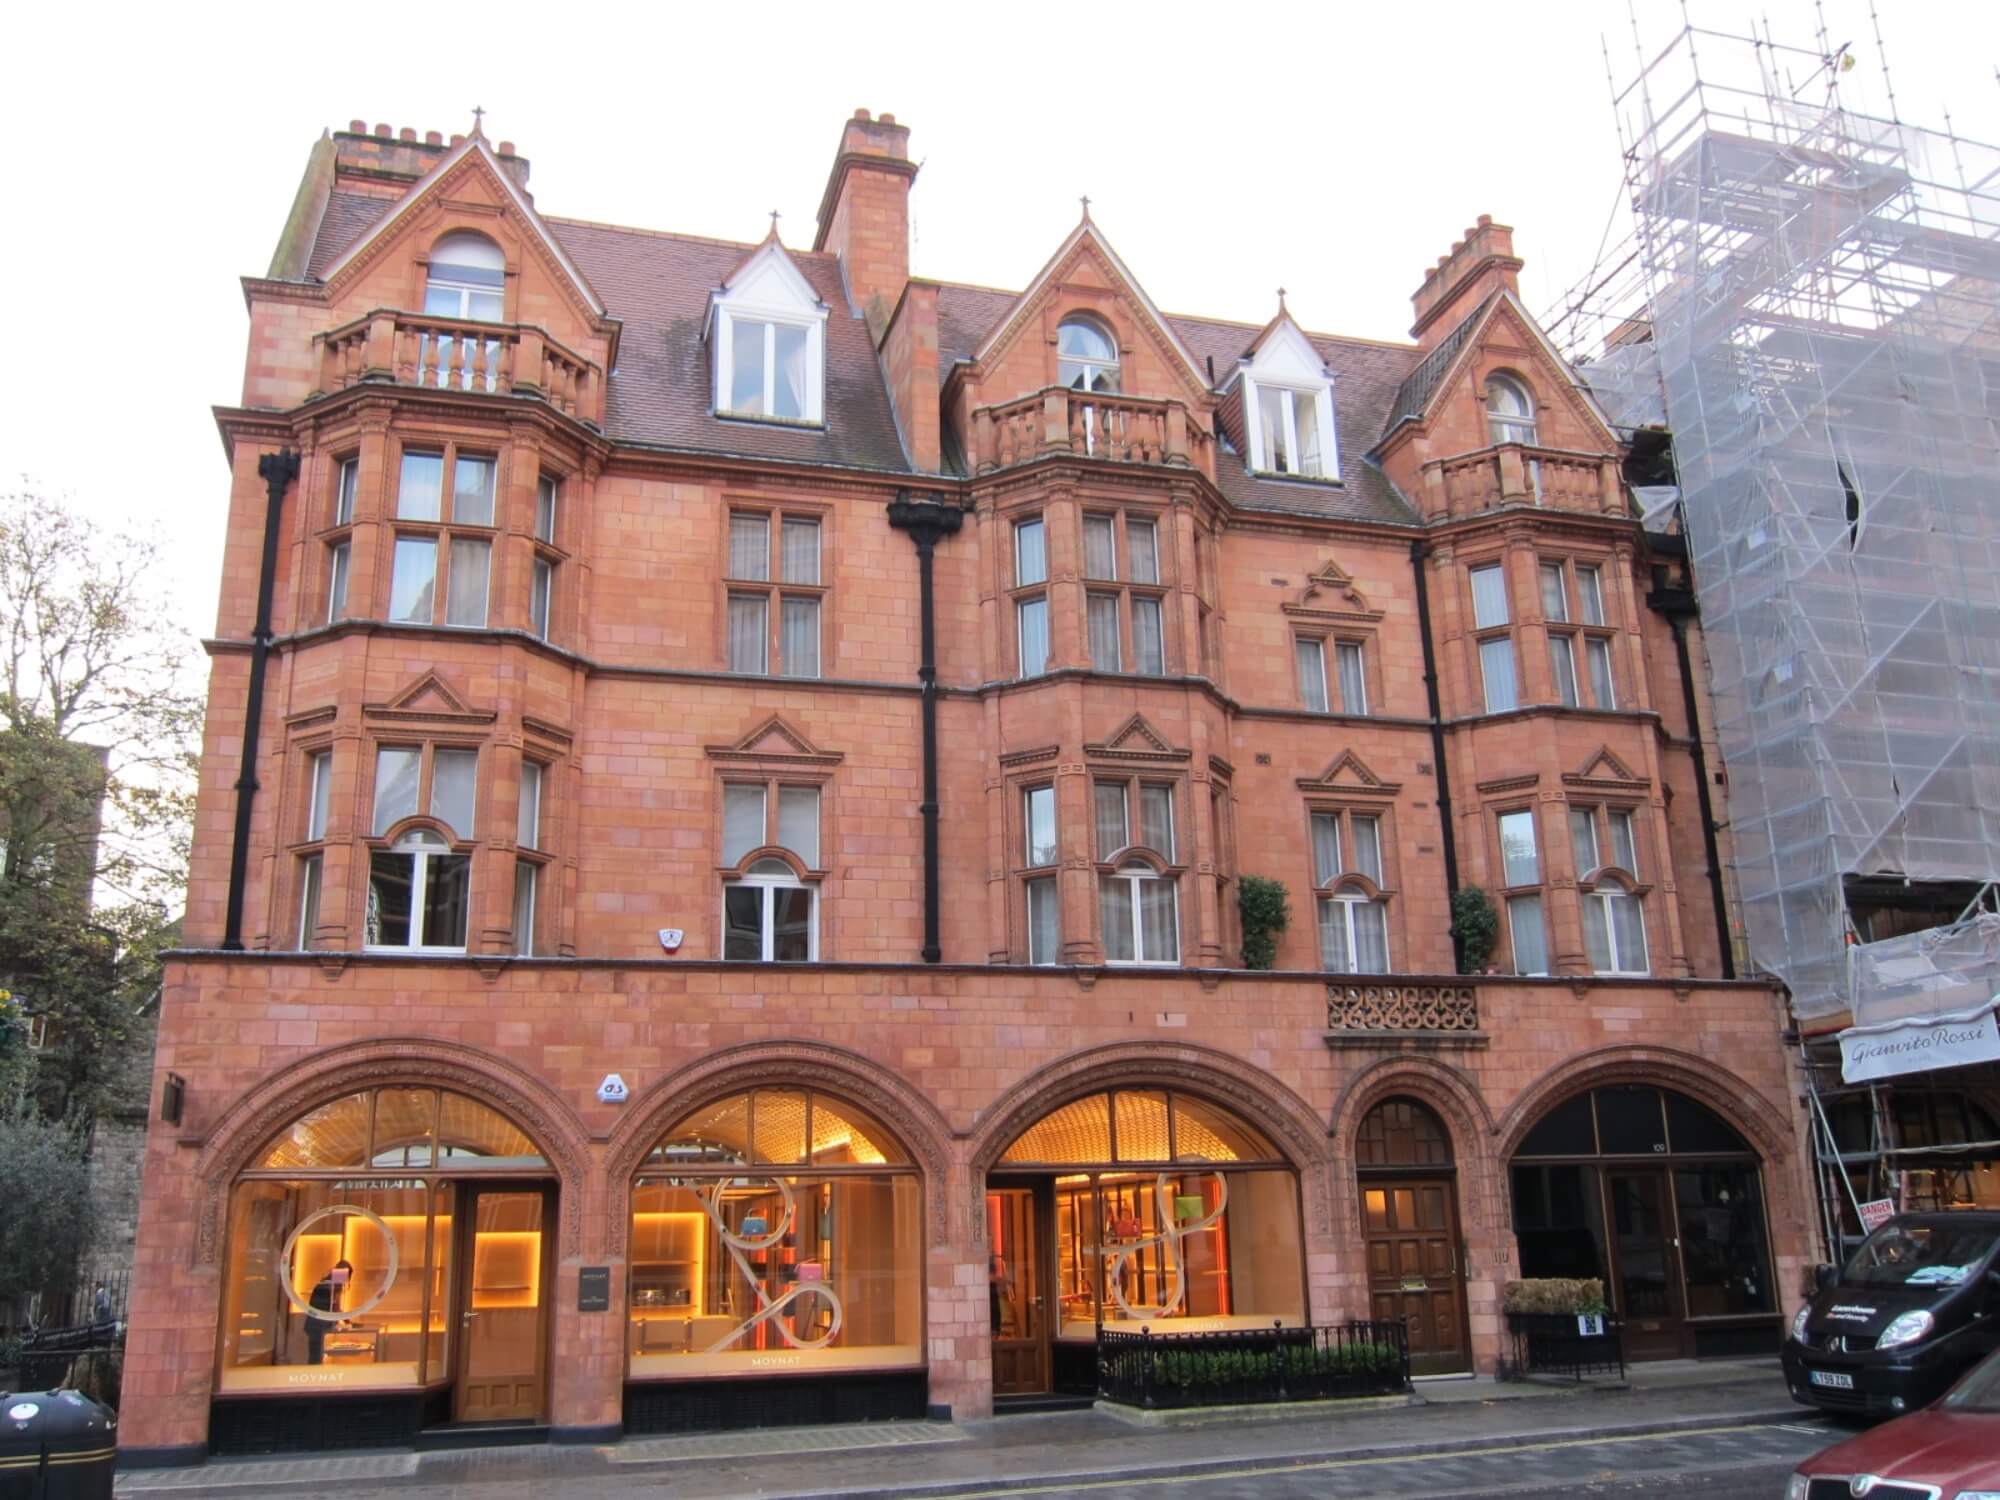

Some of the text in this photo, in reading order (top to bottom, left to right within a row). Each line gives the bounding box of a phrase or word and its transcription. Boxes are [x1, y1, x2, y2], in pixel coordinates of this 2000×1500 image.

[1851, 1035, 1931, 1065] Gianvito
[1931, 1024, 1985, 1047] Rossi
[1859, 1201, 1890, 1217] DANGER
[752, 1355, 801, 1367] MOYNAT
[288, 1372, 345, 1384] MOYNAT
